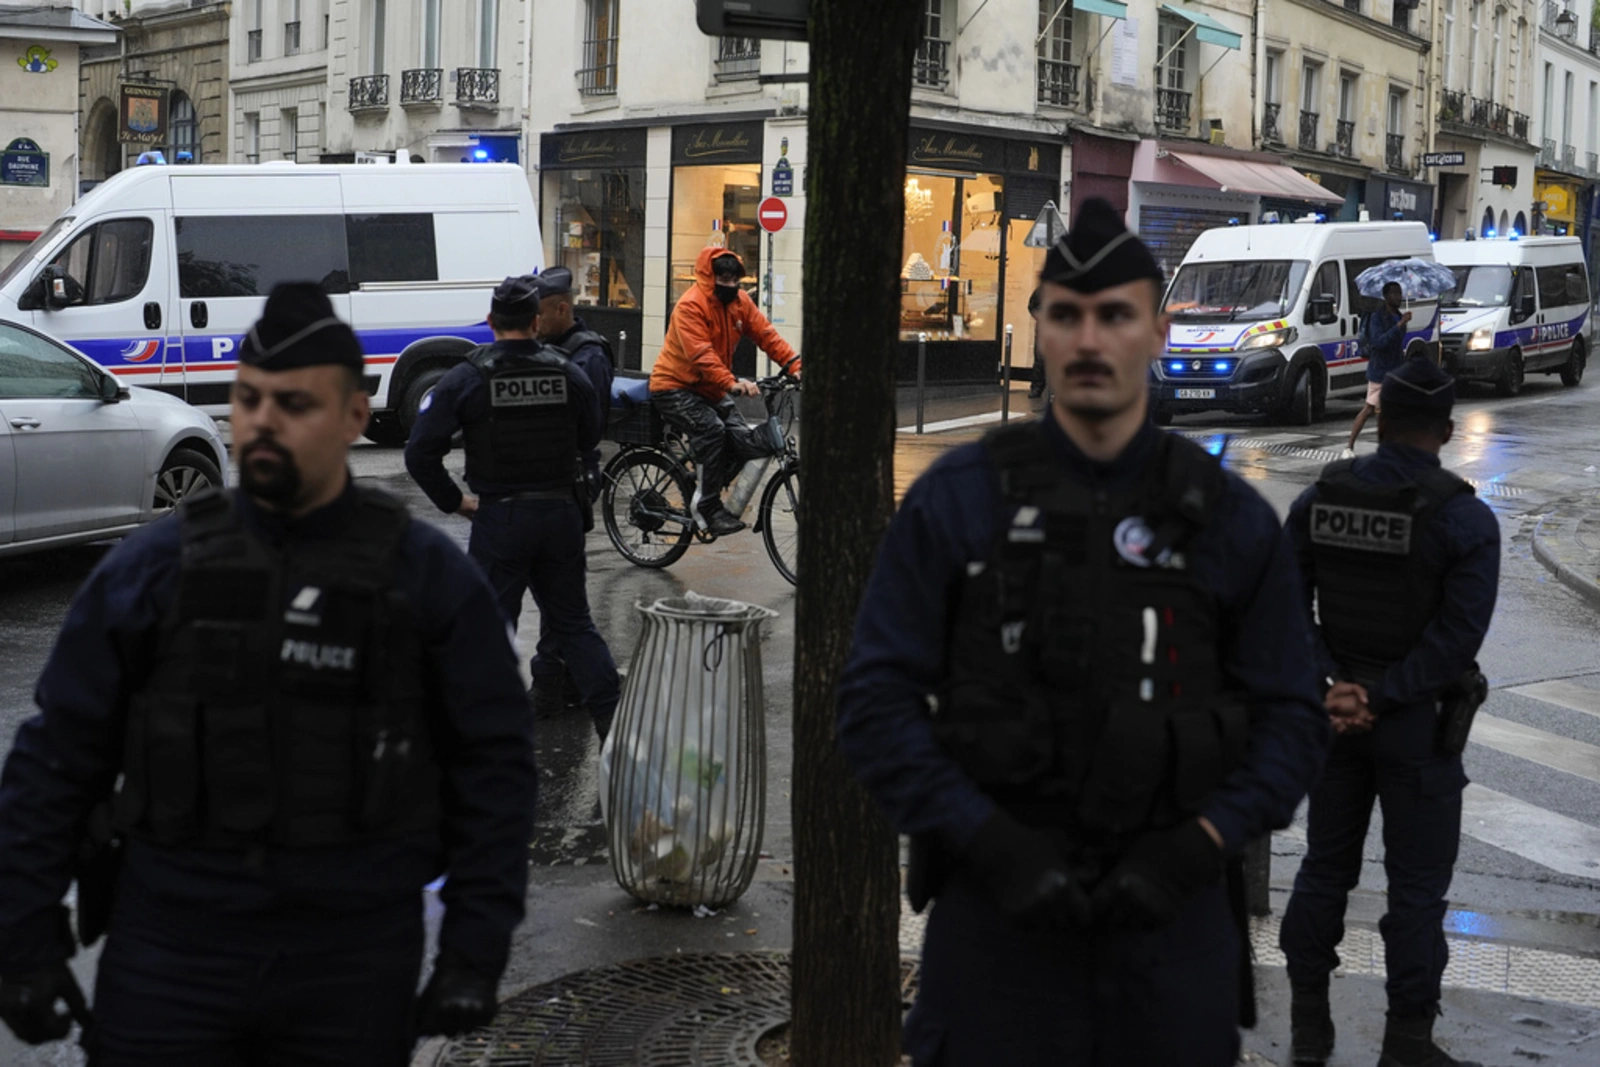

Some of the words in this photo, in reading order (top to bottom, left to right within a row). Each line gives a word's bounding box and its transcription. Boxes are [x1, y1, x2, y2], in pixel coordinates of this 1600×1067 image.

[124, 87, 162, 97] GUINNESS
[7, 162, 40, 170] DAUPHINE
[1541, 323, 1569, 341] POLICE
[211, 337, 246, 359] P
[494, 378, 564, 398] POLICE
[1314, 508, 1405, 540] POLICE
[280, 638, 356, 670] POLICE
